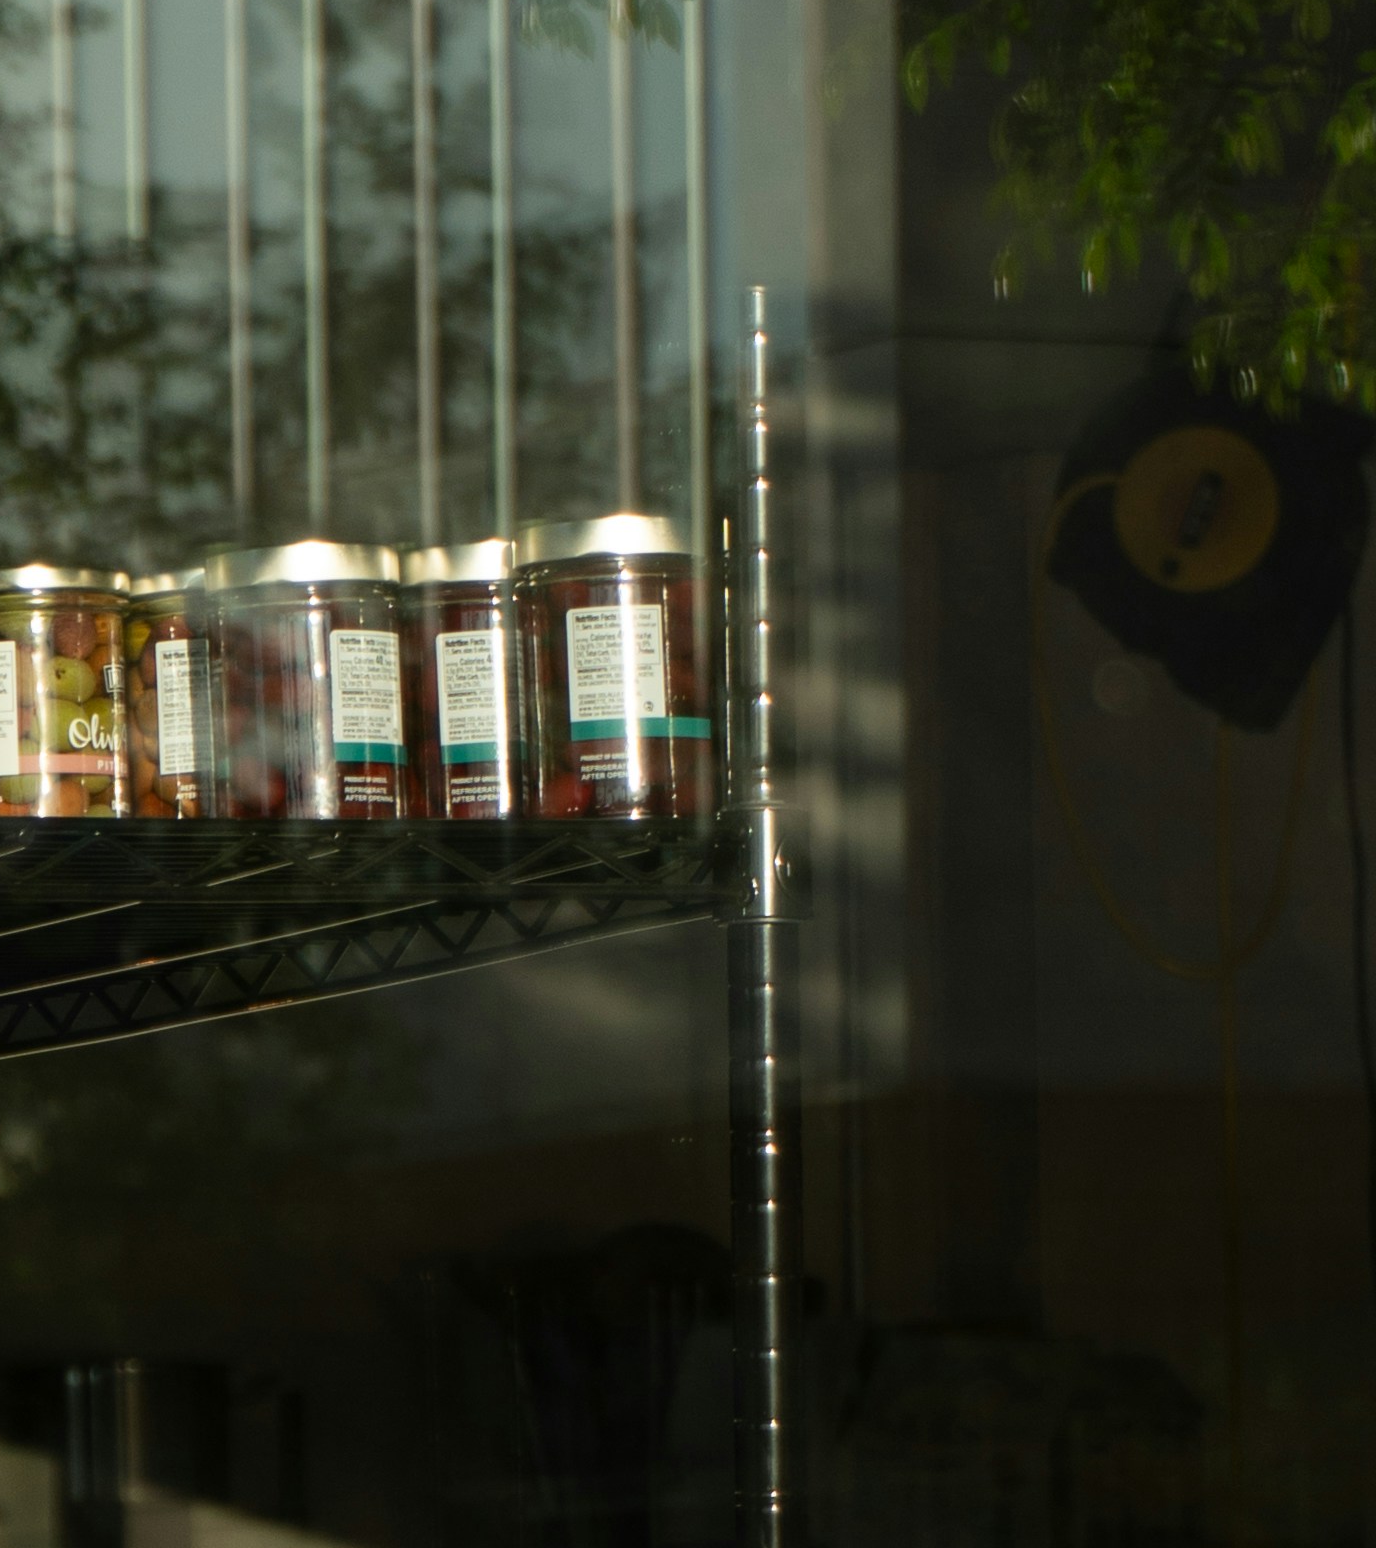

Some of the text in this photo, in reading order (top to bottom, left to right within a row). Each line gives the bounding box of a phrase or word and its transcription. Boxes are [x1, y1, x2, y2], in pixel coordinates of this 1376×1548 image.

[581, 771, 606, 781] AFTER
[451, 785, 498, 796] REFRIGERAT
[452, 794, 476, 803] AFTER
